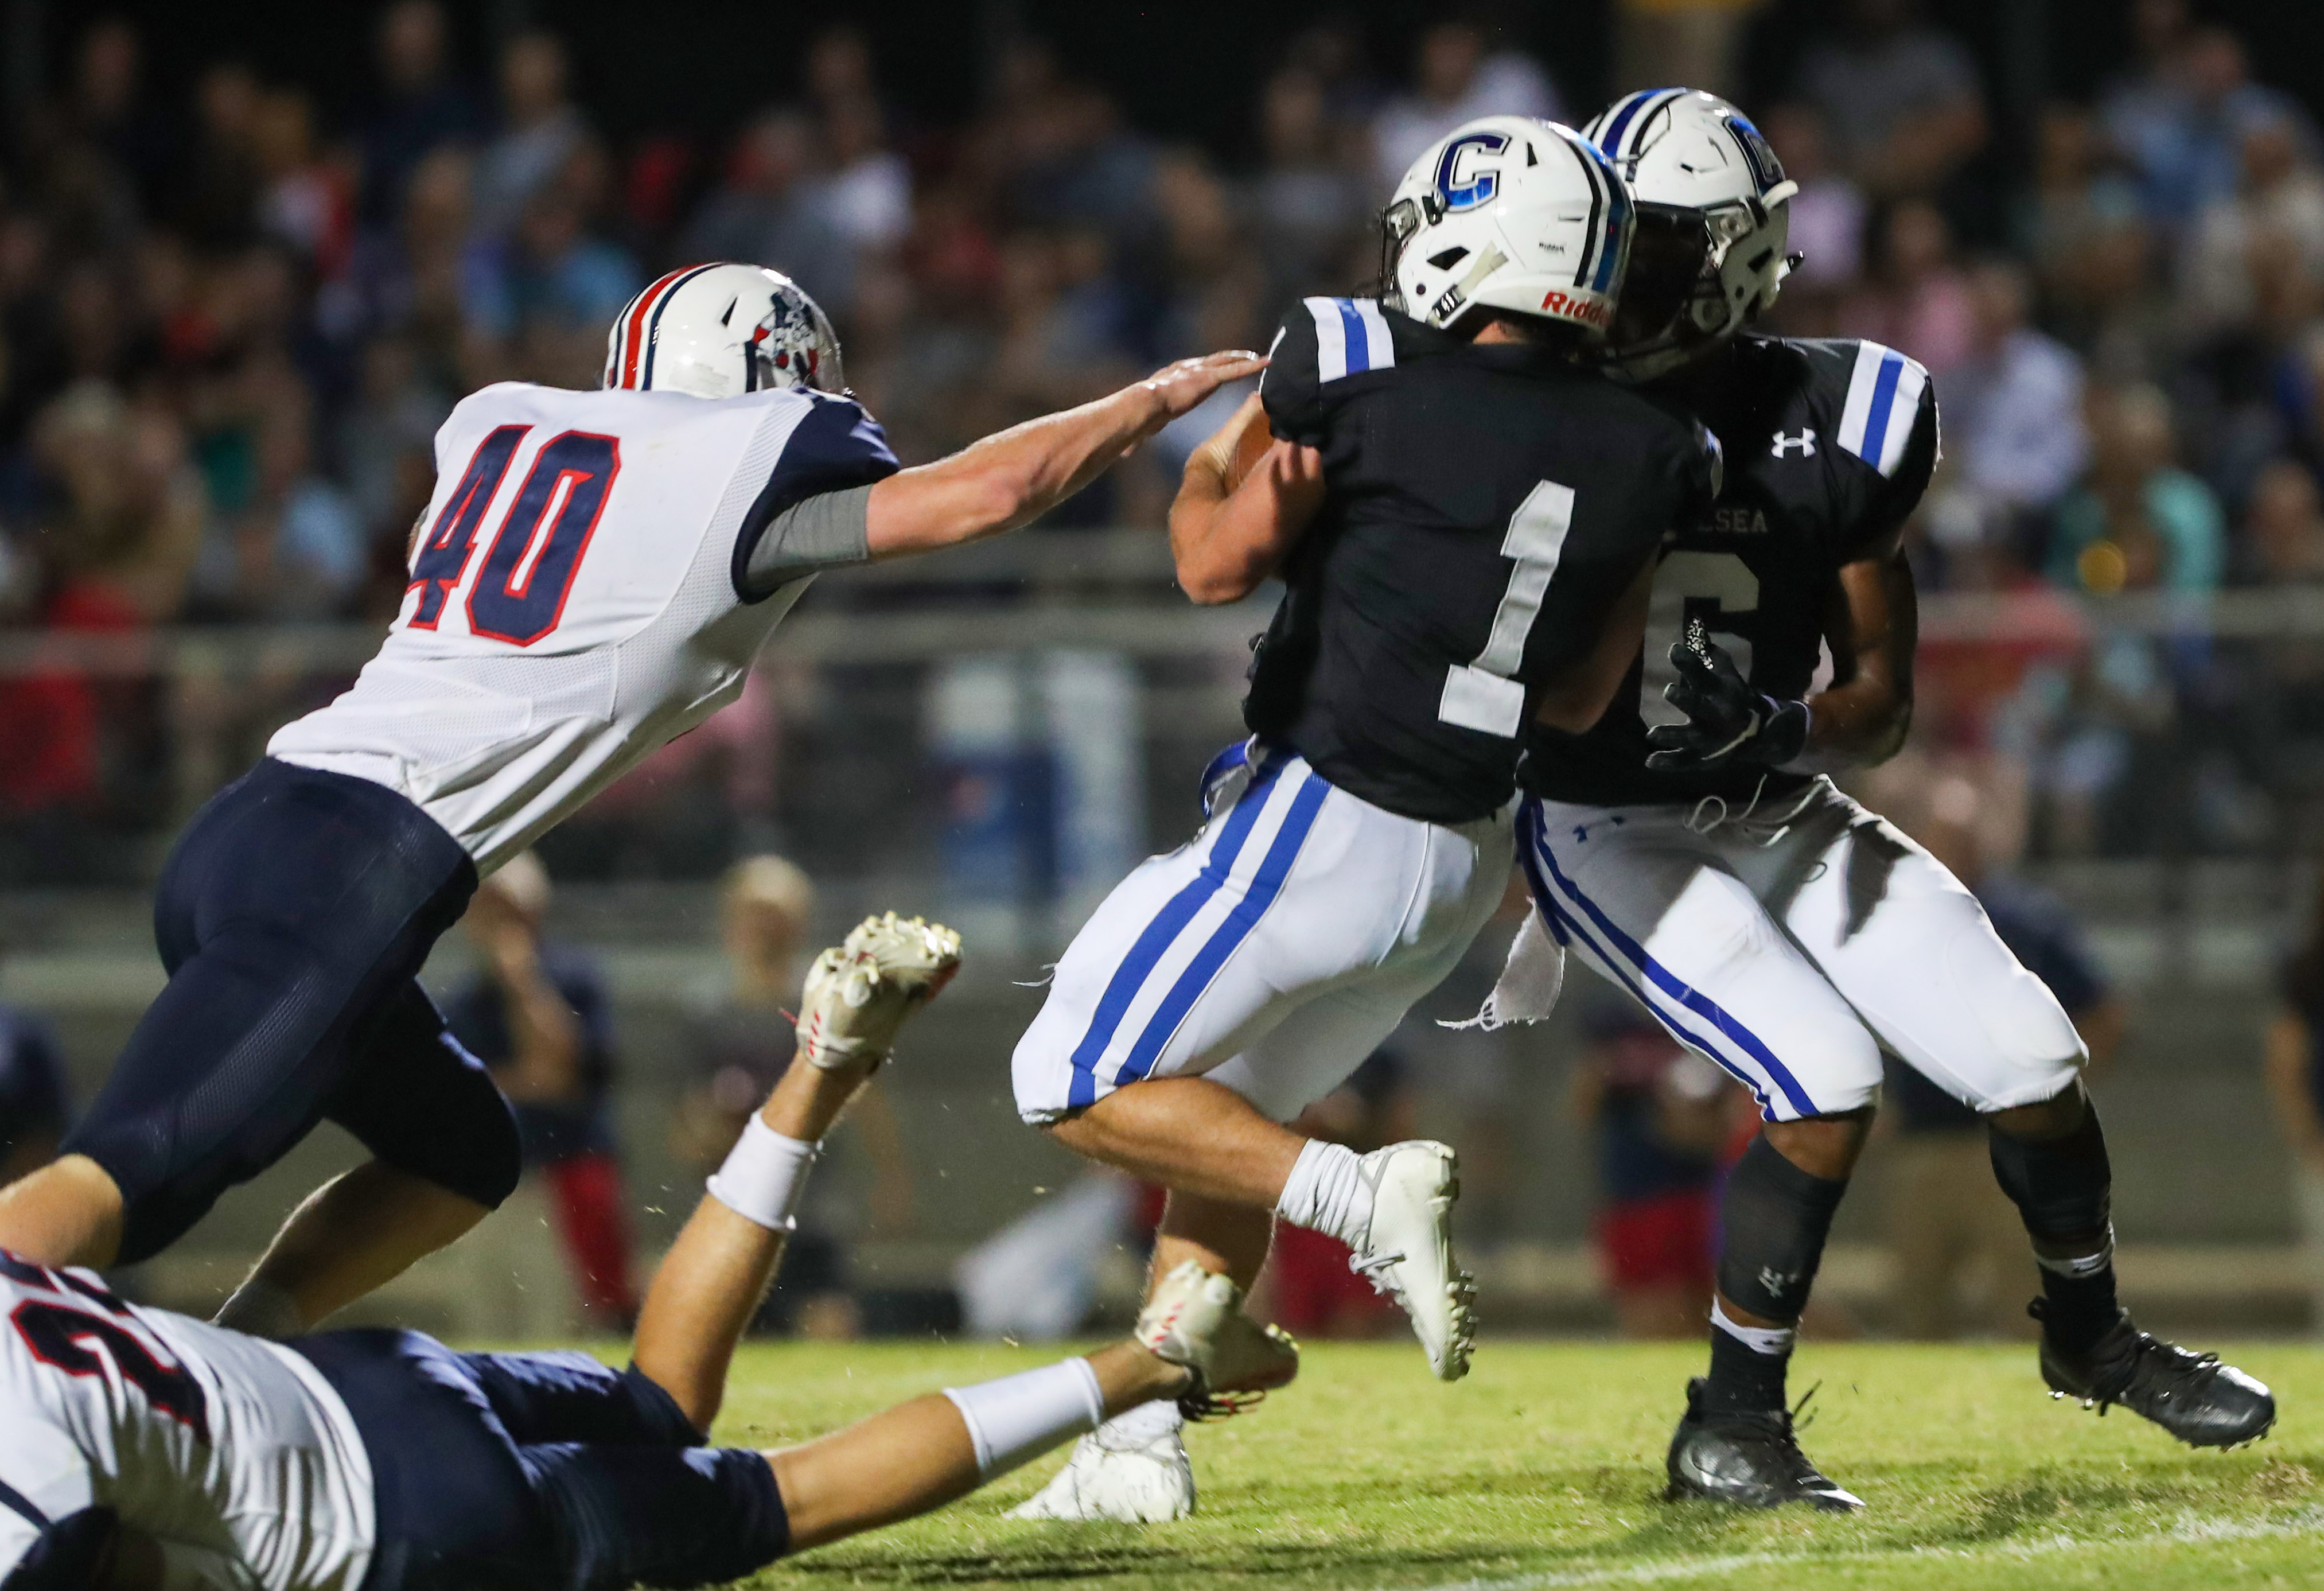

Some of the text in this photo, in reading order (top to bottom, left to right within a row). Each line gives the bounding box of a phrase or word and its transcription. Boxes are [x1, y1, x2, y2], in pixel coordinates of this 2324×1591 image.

[1433, 131, 1512, 213] C
[406, 424, 621, 648] 40
[1697, 509, 1768, 534] SEA
[1438, 479, 1575, 739] 1
